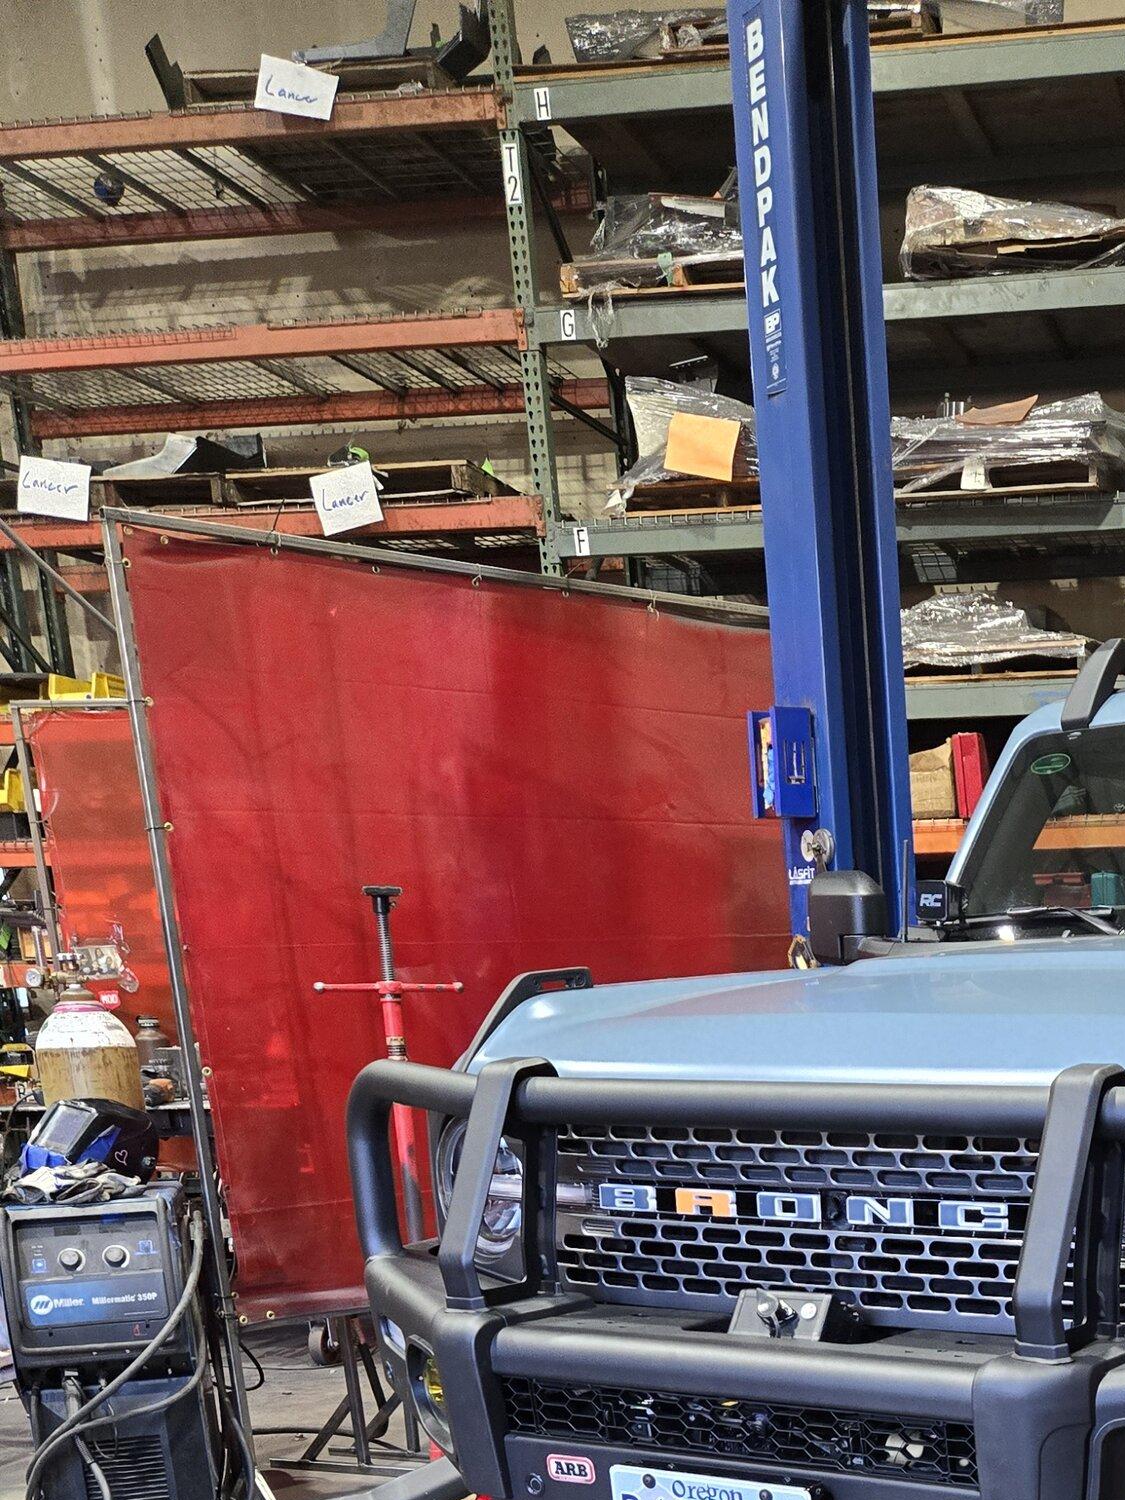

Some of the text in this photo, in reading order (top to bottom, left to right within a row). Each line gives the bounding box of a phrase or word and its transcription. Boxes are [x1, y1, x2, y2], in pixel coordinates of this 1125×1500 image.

[536, 91, 550, 118] H
[746, 18, 780, 308] BENDPAK
[562, 312, 574, 337] G
[322, 488, 369, 511] Lancer
[576, 529, 585, 553] F
[919, 893, 942, 907] RC
[598, 1183, 1009, 1232] BRONC
[554, 1461, 588, 1477] ARB
